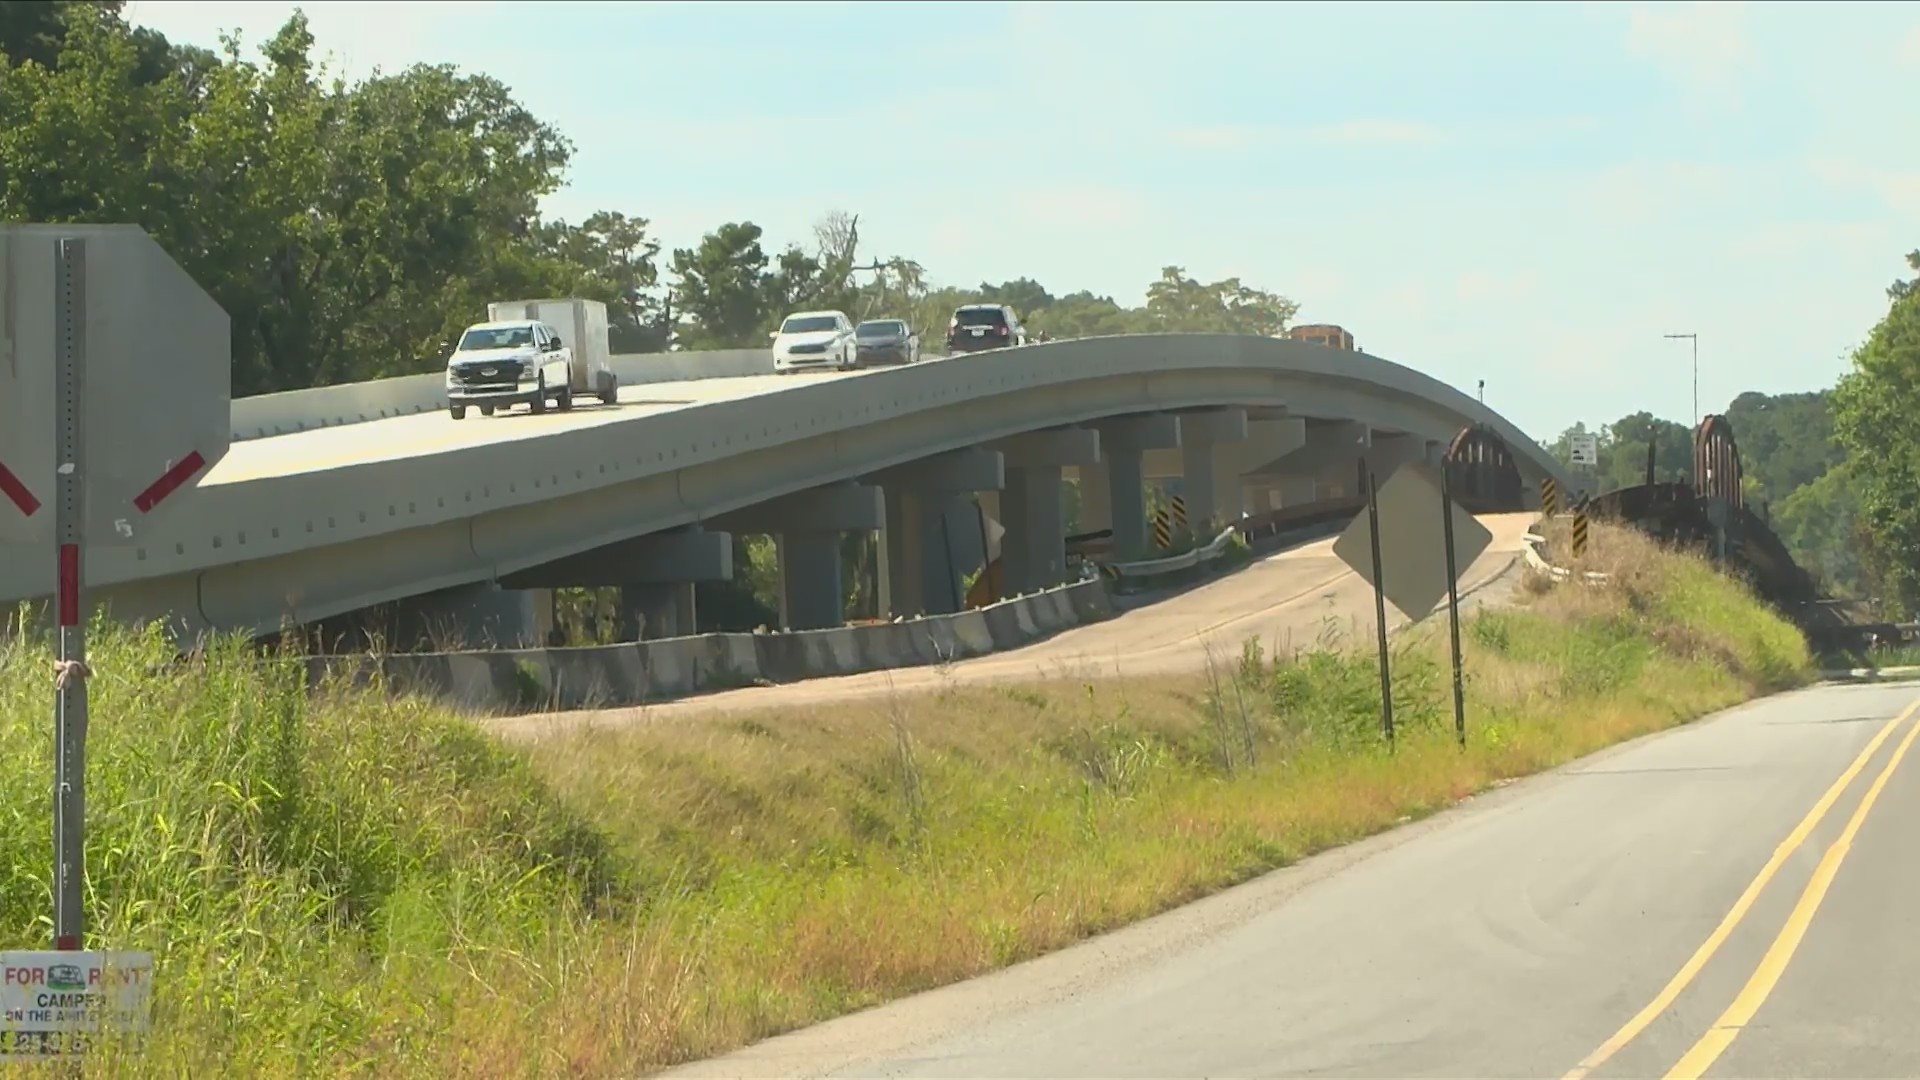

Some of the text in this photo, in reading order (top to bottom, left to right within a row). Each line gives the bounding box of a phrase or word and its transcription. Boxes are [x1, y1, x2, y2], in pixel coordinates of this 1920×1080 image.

[4, 967, 142, 985] FOR RNT
[5, 1010, 23, 1022] ON
[28, 1010, 52, 1022] THE
